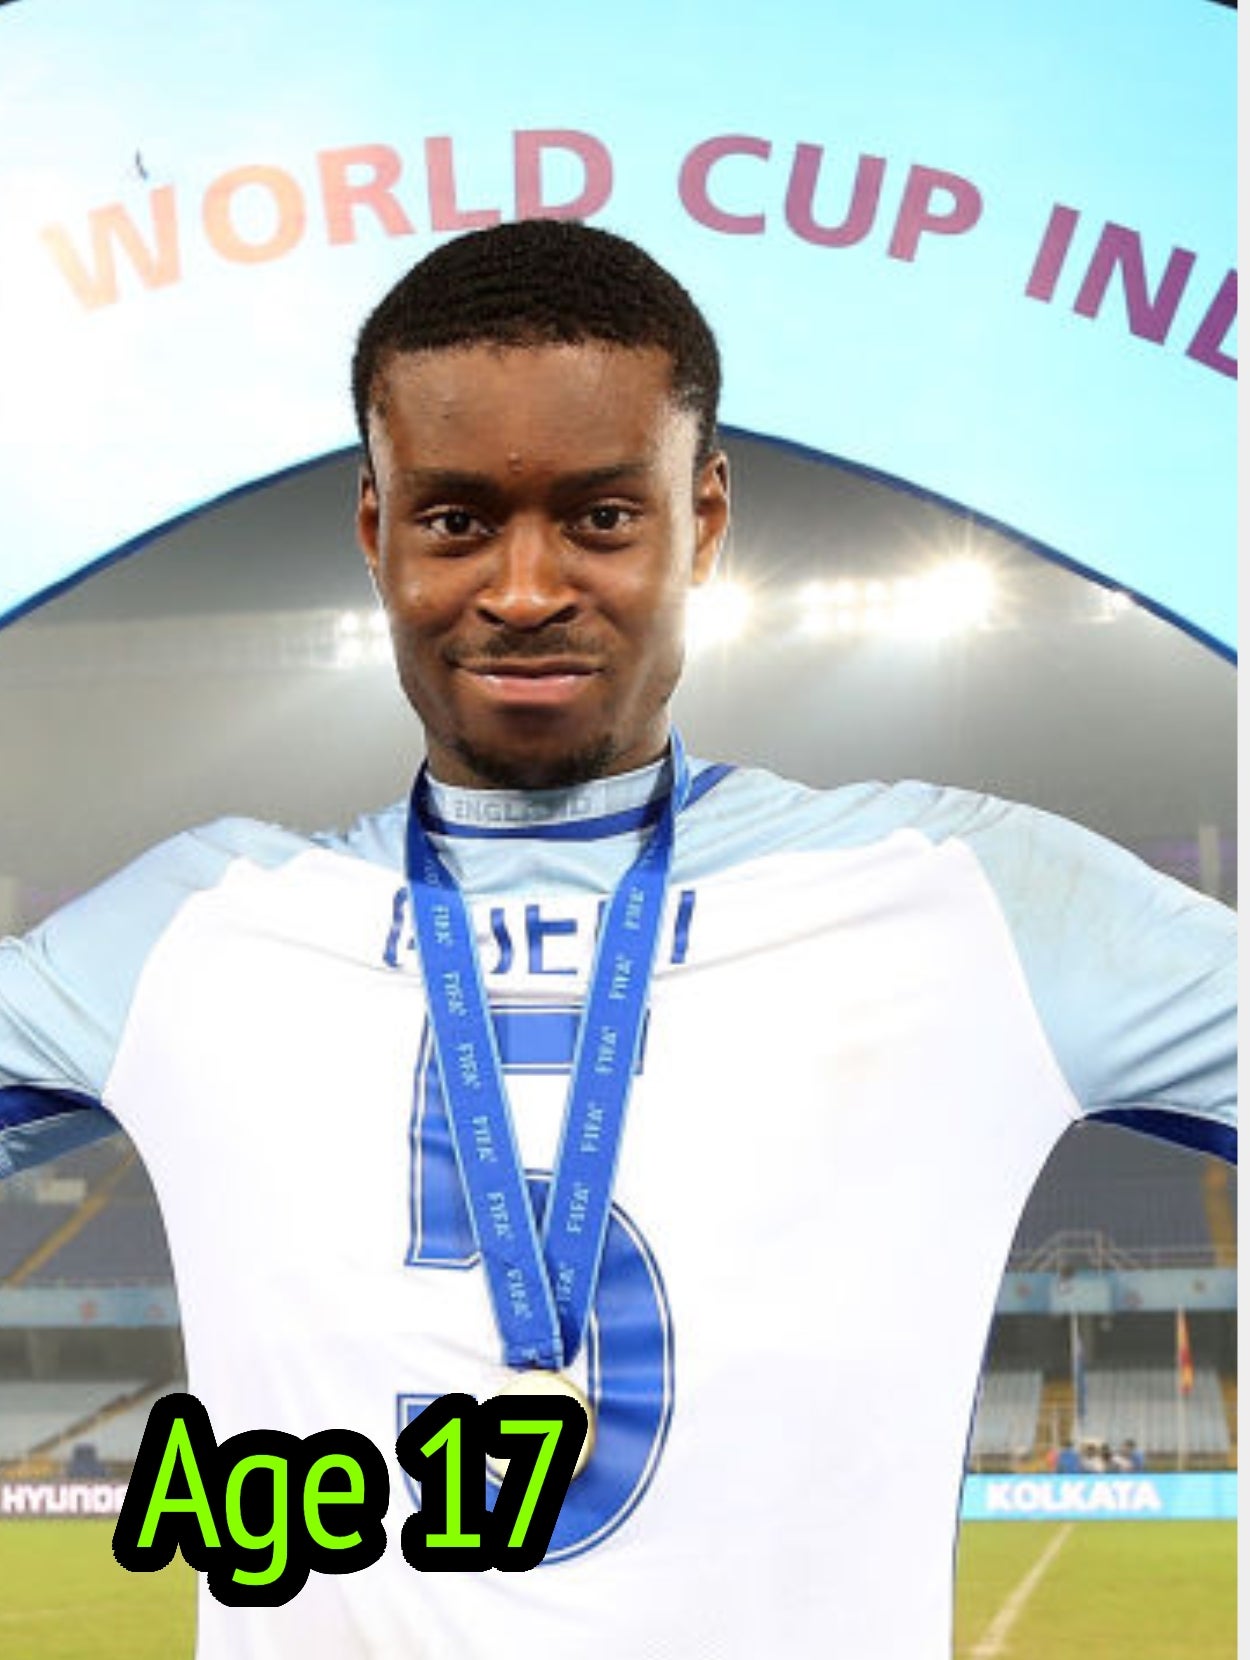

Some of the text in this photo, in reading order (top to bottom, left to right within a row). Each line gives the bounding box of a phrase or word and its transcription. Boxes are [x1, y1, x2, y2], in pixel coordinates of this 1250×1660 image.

[39, 128, 615, 313] WORLD
[677, 132, 984, 263] CUP
[985, 1481, 1162, 1512] KOLKATA
